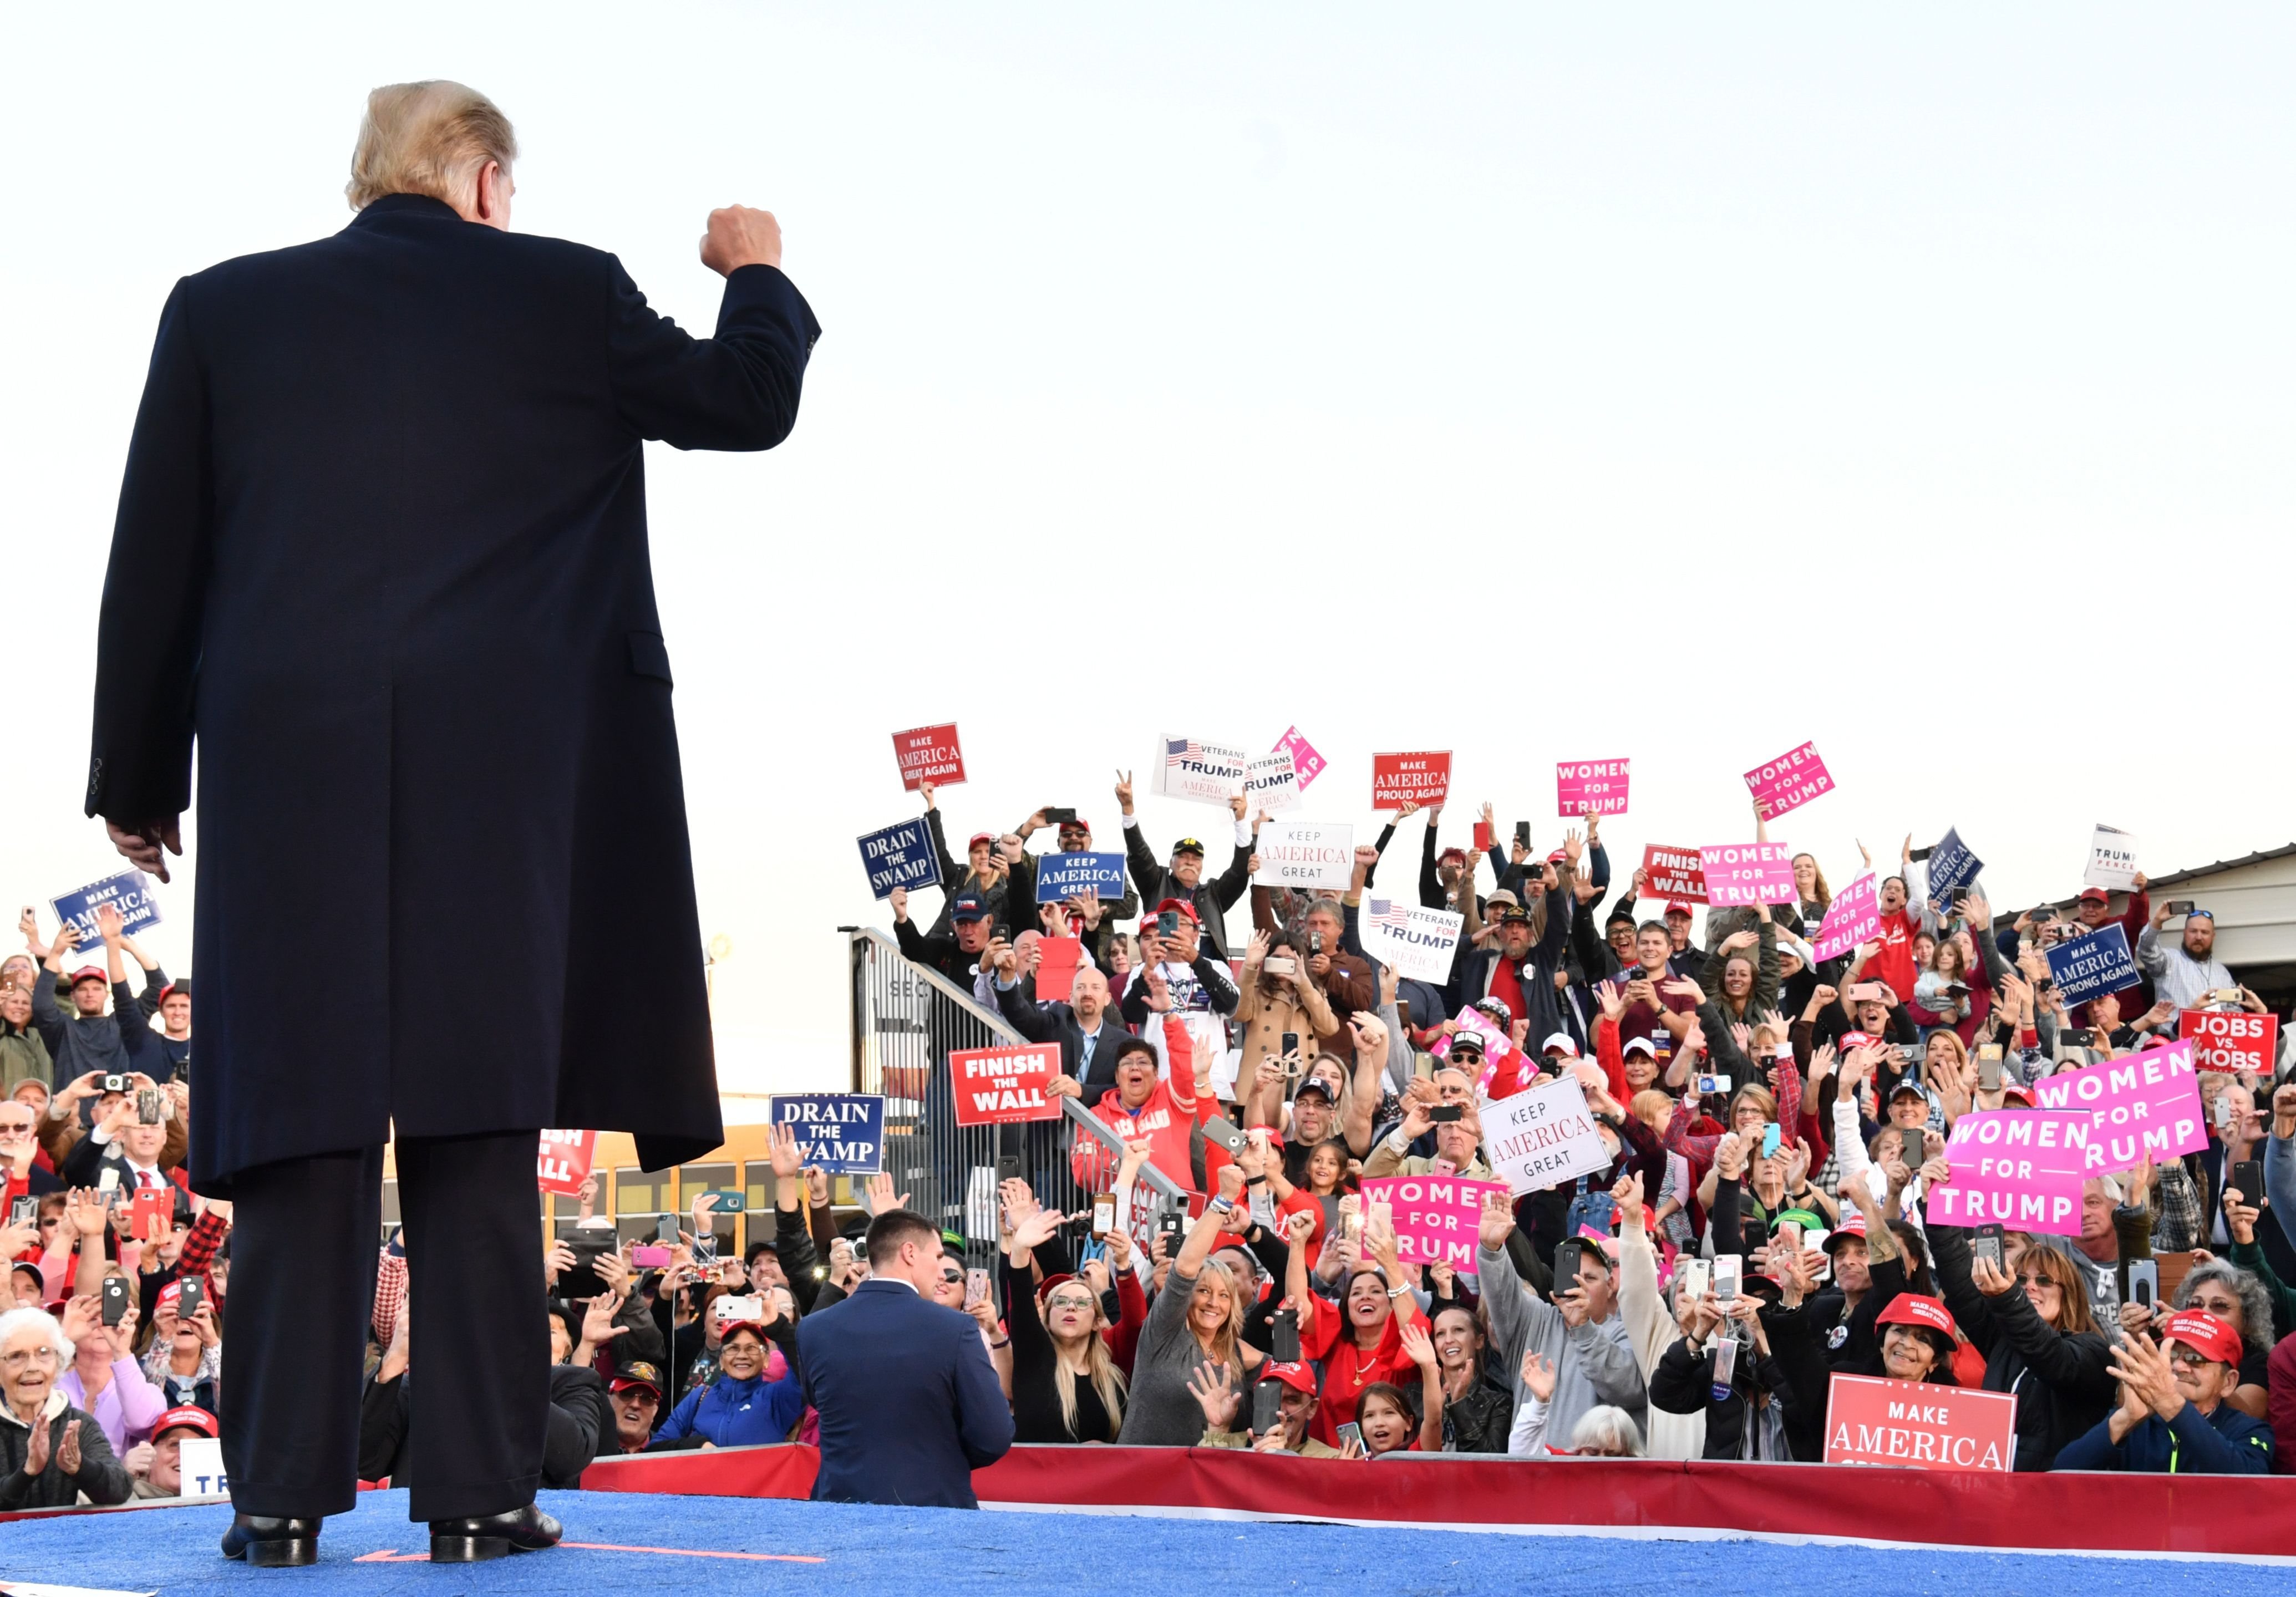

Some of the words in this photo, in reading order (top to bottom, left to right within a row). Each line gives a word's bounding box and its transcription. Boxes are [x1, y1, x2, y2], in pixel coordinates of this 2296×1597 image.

[910, 736, 932, 747] MAKE
[899, 745, 960, 768] AMERICA
[1201, 745, 1246, 759] VETERANS
[905, 768, 923, 780] GREAT
[925, 763, 957, 776] AGAIN
[1180, 760, 1243, 779] TRUMP
[1227, 759, 1243, 767] FOR
[1246, 756, 1291, 770] VETERANS
[1275, 764, 1292, 773] FOR
[1400, 761, 1426, 770] MAKE
[1557, 762, 1629, 780] WOMEN
[1745, 744, 1818, 788] WOMEN
[1181, 781, 1233, 796] AMERICA
[1244, 772, 1294, 791] RUMP
[1375, 771, 1447, 787] AMERICA
[1584, 783, 1609, 794] FOR
[1775, 773, 1801, 792] FOR
[1250, 793, 1292, 808] MERICA
[1376, 790, 1414, 800] PROUD
[1416, 787, 1445, 799] AGAIN
[1562, 797, 1626, 813] TRUMP
[866, 828, 917, 858] DRAIN
[1288, 831, 1320, 841] KEEP
[885, 851, 906, 867] THE
[1065, 858, 1098, 867] KEEP
[1259, 846, 1347, 863] AMERICA
[1701, 846, 1790, 864] WOMEN
[1931, 850, 1947, 872] MAKE
[872, 858, 927, 889] SWAMP
[1282, 866, 1322, 878] GREAT
[1670, 869, 1689, 879] THE
[1955, 853, 1976, 880] AGAIN
[2097, 859, 2134, 870] PENCE
[1040, 869, 1121, 885] AMERICA
[1732, 868, 1764, 881] FOR
[85, 885, 119, 905] MAKE
[1653, 877, 1707, 897] WALL
[1712, 883, 1791, 902] TRUMP
[1830, 877, 1876, 913] OMEN
[123, 906, 151, 926] GAIN
[1406, 909, 1459, 928] VETERANS
[1833, 909, 1857, 929] FOR
[1381, 923, 1454, 950] TRUMP
[1436, 926, 1456, 937] FOR
[1818, 916, 1876, 957] TRUMP
[2071, 942, 2098, 959] MAKE
[2055, 947, 2129, 985] AMERICA
[2059, 975, 2100, 998] STRONG
[2101, 963, 2134, 983] AGAIN
[2193, 1016, 2263, 1038] JOBS
[965, 1054, 1045, 1078] FINISH
[2198, 1048, 2262, 1070] MOBS
[992, 1077, 1018, 1089] THE
[2038, 1047, 2192, 1108] WOMEN
[972, 1087, 1045, 1112] WALL
[783, 1102, 870, 1123] DRAIN
[1510, 1102, 1546, 1126] KEEP
[2092, 1101, 2149, 1130] FOR
[809, 1125, 841, 1139] THE
[1495, 1114, 1591, 1164] AMERICA
[1952, 1120, 2089, 1150] WOMEN
[794, 1141, 874, 1162] WAMP
[2085, 1118, 2195, 1169] RUMP
[1523, 1150, 1571, 1177] GREAT
[1980, 1158, 2032, 1179] FOR
[1938, 1188, 2073, 1223] TRUMP
[1410, 1212, 1458, 1231] FOR
[1397, 1234, 1470, 1264] RUM
[1909, 1301, 1929, 1310] MAKE
[1929, 1306, 1950, 1325] AMERICA
[1912, 1308, 1933, 1319] GREAT
[1933, 1315, 1948, 1330] AGAIN
[2186, 1319, 2218, 1335] AMERICA
[2191, 1328, 2213, 1340] AGAIN
[1888, 1401, 1949, 1425] MAKE
[1830, 1422, 2003, 1471] AMERICA
